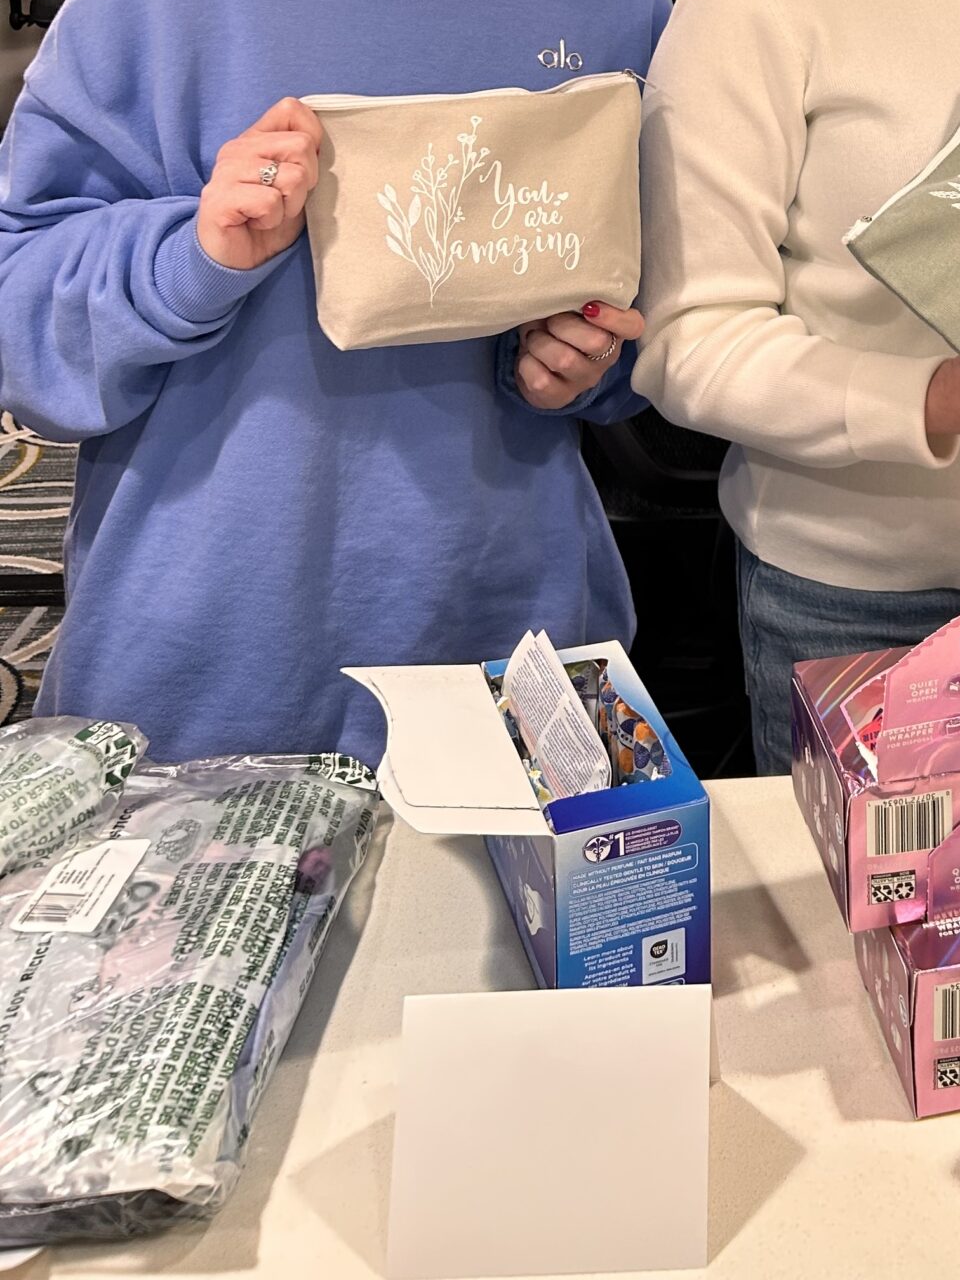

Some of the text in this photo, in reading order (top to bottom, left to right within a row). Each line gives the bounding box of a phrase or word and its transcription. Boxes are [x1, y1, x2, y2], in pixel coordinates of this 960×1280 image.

[537, 38, 584, 70] alo
[480, 161, 557, 229] You
[524, 207, 563, 228] are
[450, 227, 585, 275] amazing
[909, 678, 939, 690] QUIET
[911, 687, 937, 697] OPEN
[906, 693, 937, 704] WRAPPER
[886, 735, 933, 749] FOR DISPOSAL
[888, 726, 933, 741] WRAPPER
[290, 780, 310, 803] PLASTIC
[8, 794, 28, 813] OF
[7, 813, 26, 831] TO
[67, 804, 97, 829] NOT
[55, 821, 70, 835] A
[25, 830, 57, 852] TOY
[609, 830, 624, 858] #1
[210, 921, 228, 939] USE
[227, 927, 241, 939] DE
[219, 940, 236, 956] LOS
[181, 983, 214, 1030] ENFANTS
[166, 1030, 191, 1061] POUR
[146, 1063, 179, 1105] ÉVITER
[155, 1027, 212, 1127] DES ET DES
[199, 1086, 224, 1119] TENIR
[131, 1105, 157, 1140] TOUT
[192, 1120, 208, 1134] LE
[181, 1133, 202, 1157] SAC
